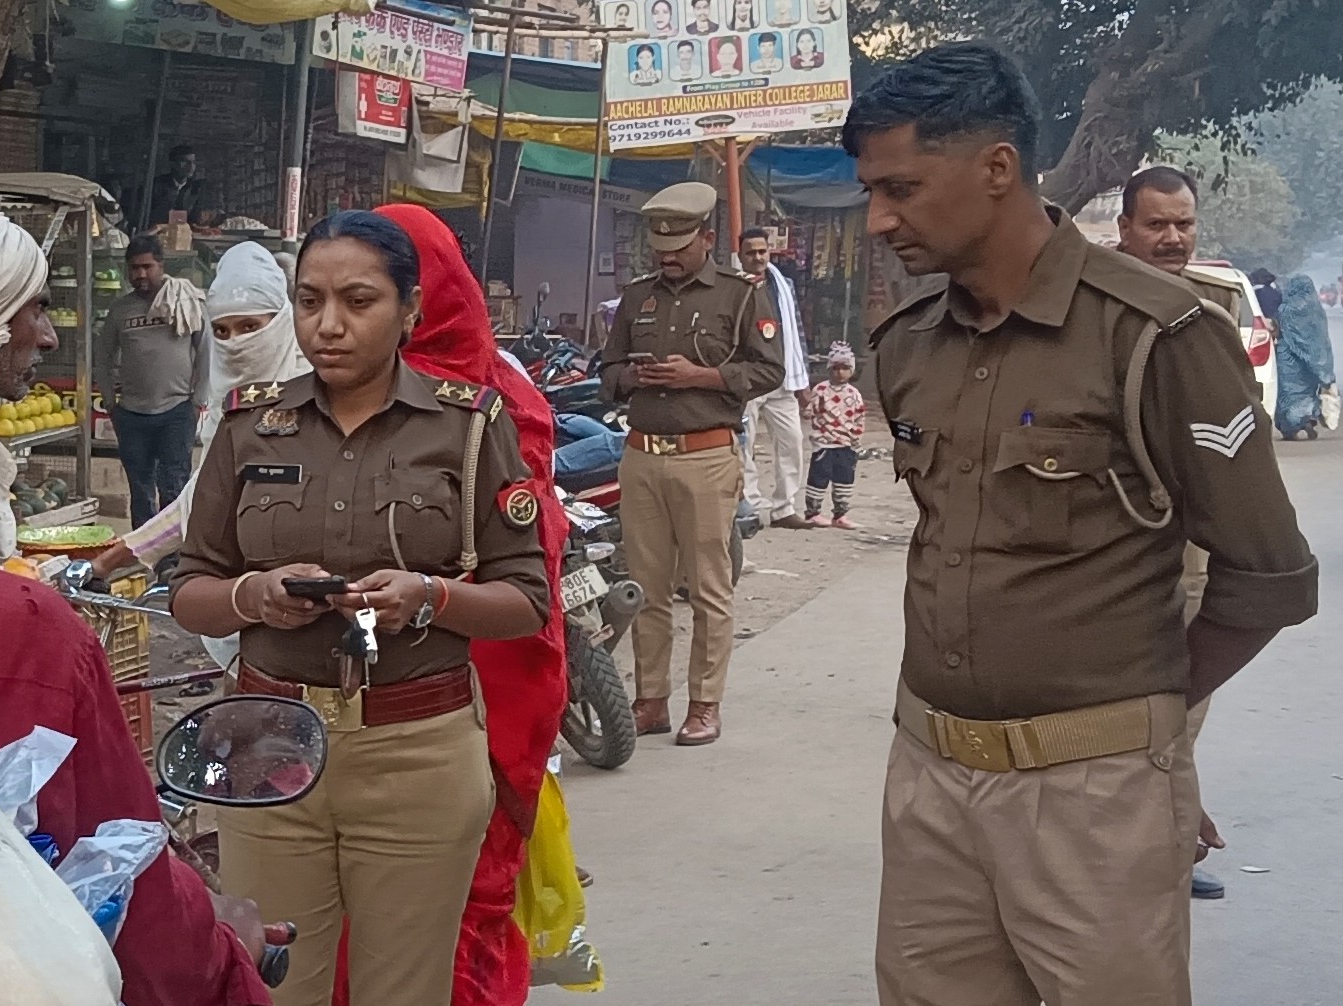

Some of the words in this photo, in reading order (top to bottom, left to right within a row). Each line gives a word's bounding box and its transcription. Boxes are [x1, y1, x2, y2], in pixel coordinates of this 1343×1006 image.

[661, 94, 731, 115] RAMNARAYAN
[732, 90, 764, 109] INTER
[766, 86, 811, 105] COLLEGE
[812, 82, 846, 102] JARAR
[737, 108, 771, 119] Vehicle
[773, 105, 808, 118] Facility
[609, 119, 660, 132] Contact
[751, 118, 795, 130] Available
[559, 183, 595, 196] MEDICA
